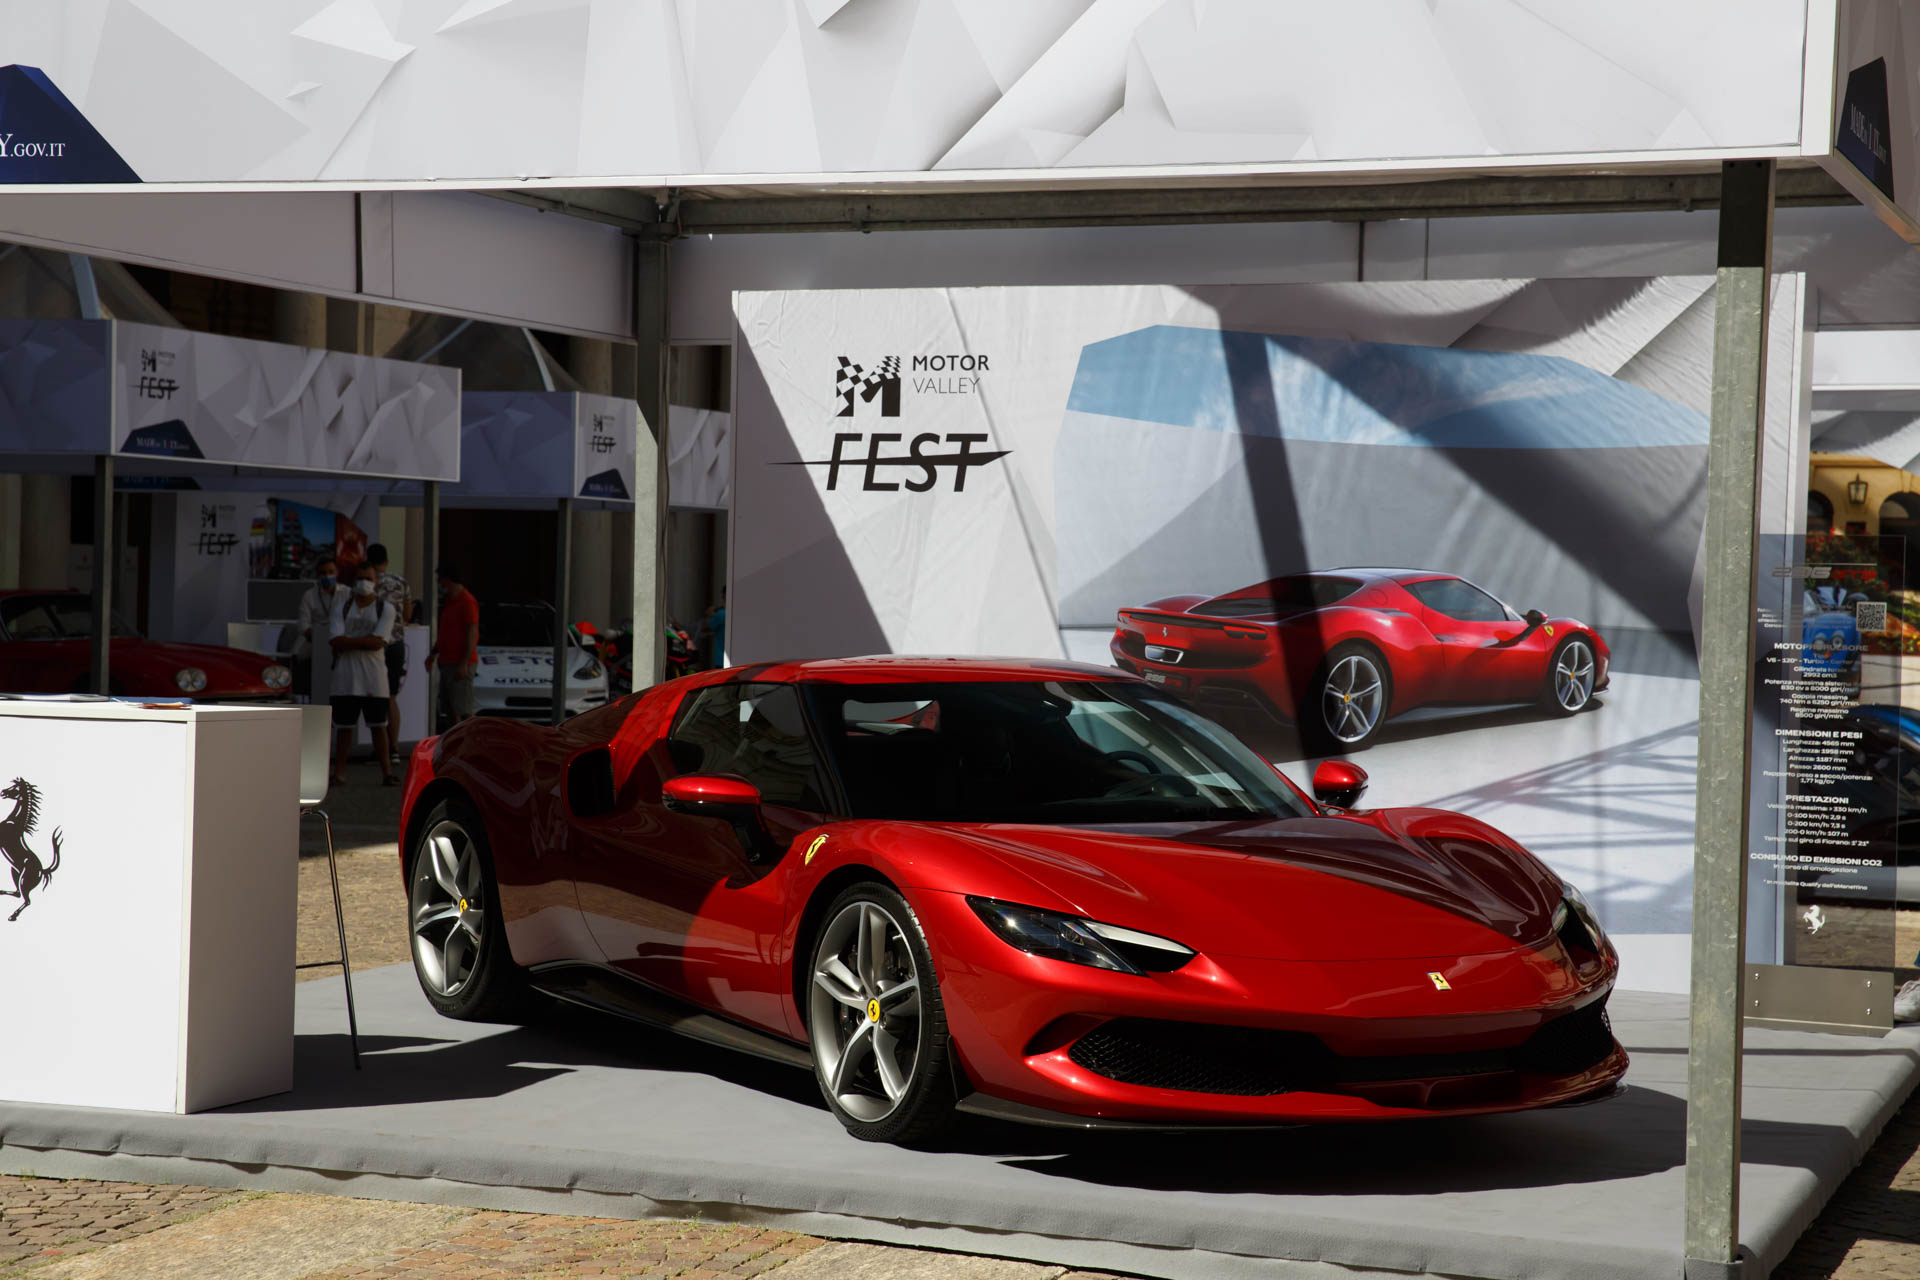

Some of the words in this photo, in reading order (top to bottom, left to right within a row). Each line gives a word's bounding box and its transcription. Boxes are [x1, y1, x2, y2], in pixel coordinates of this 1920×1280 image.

[912, 354, 990, 372] MOTOR
[140, 376, 176, 400] FEST
[912, 377, 981, 394] VALLEY
[826, 432, 989, 493] FEST
[1775, 729, 1832, 738] DIMENSIONI
[1785, 795, 1849, 804] PRESTAZIONI
[1750, 853, 1798, 862] CONSUMO
[1813, 856, 1861, 865] EMISSIONI
